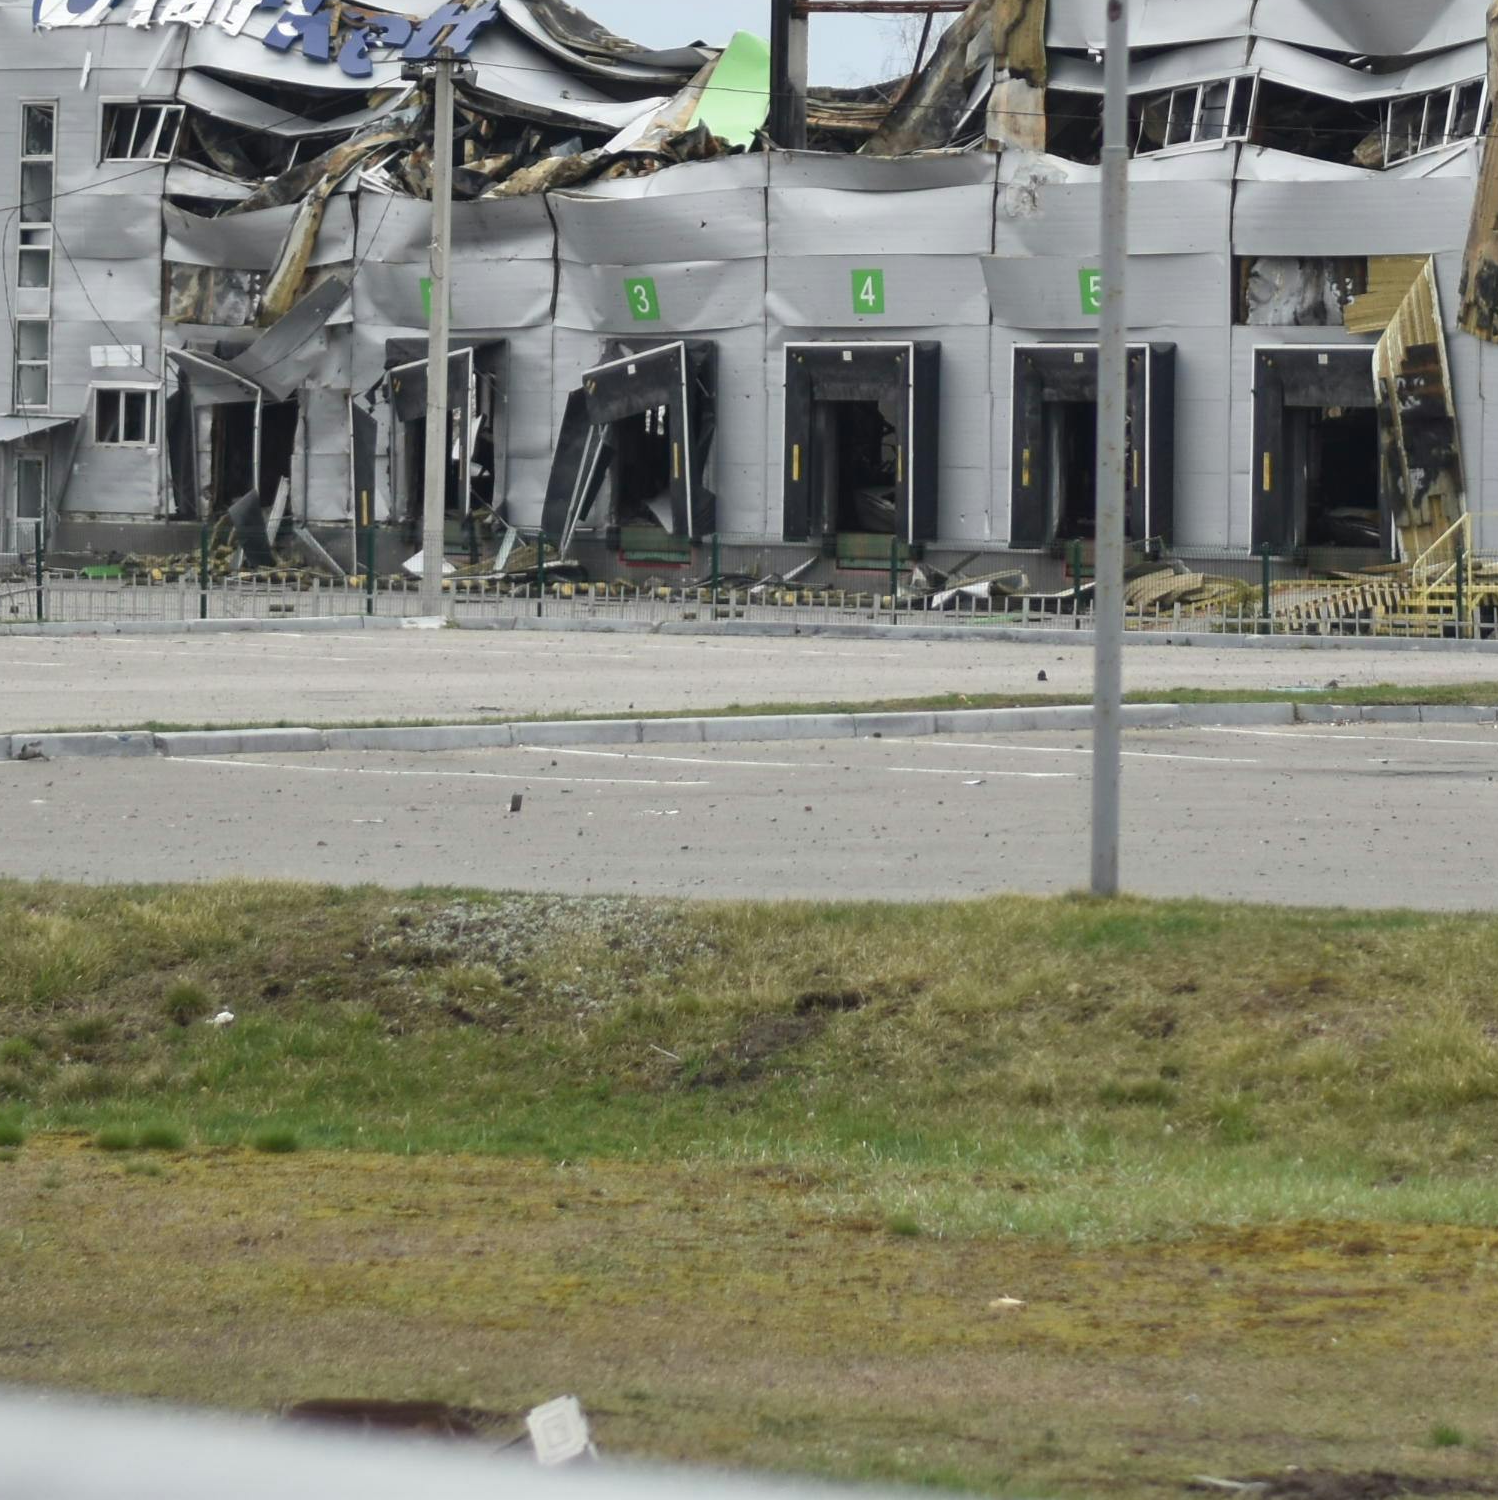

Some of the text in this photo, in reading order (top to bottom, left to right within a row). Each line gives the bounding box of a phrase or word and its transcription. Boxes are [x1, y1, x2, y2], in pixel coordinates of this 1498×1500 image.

[633, 284, 650, 313] 3
[860, 275, 876, 306] 4
[1089, 275, 1102, 307] 5
